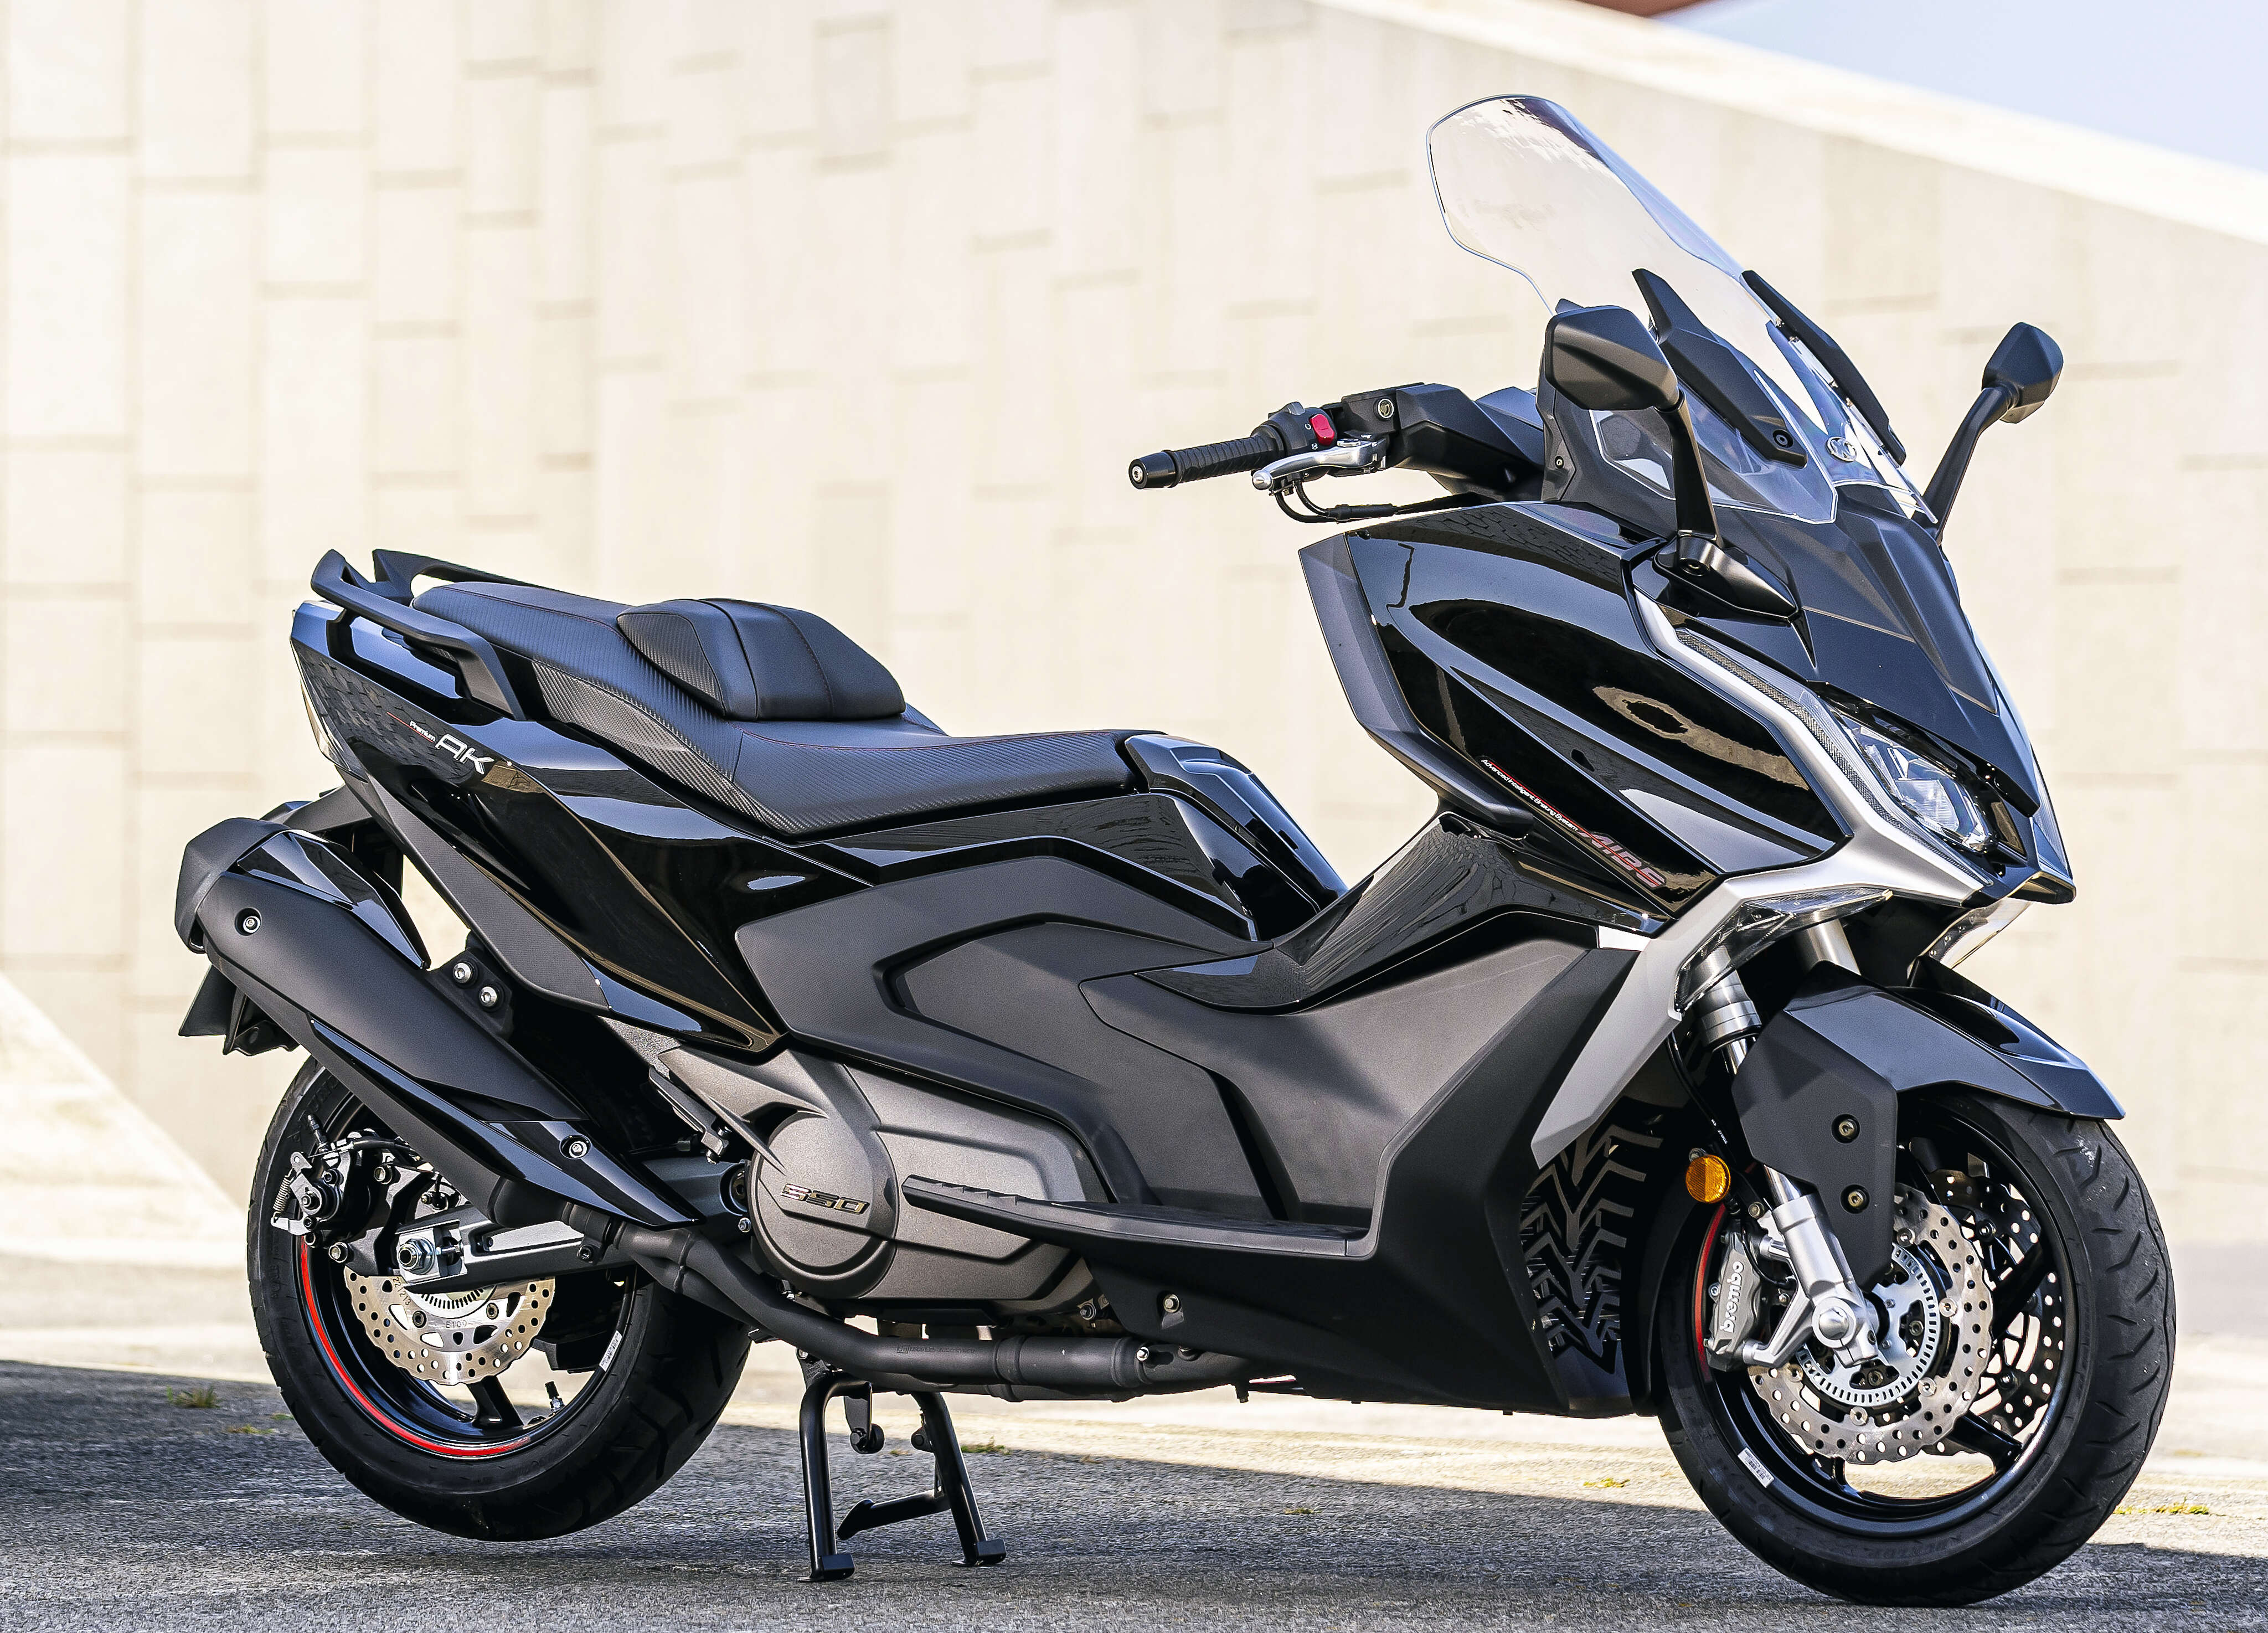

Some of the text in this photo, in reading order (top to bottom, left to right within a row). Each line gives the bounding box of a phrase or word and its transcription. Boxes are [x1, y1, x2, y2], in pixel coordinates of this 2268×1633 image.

[409, 720, 495, 774] Premium AK
[1481, 759, 1578, 831] Advanced Intelligent Braking System
[780, 1183, 870, 1215] 550
[392, 1276, 412, 1306] 221213
[1719, 1261, 1744, 1333] brembo
